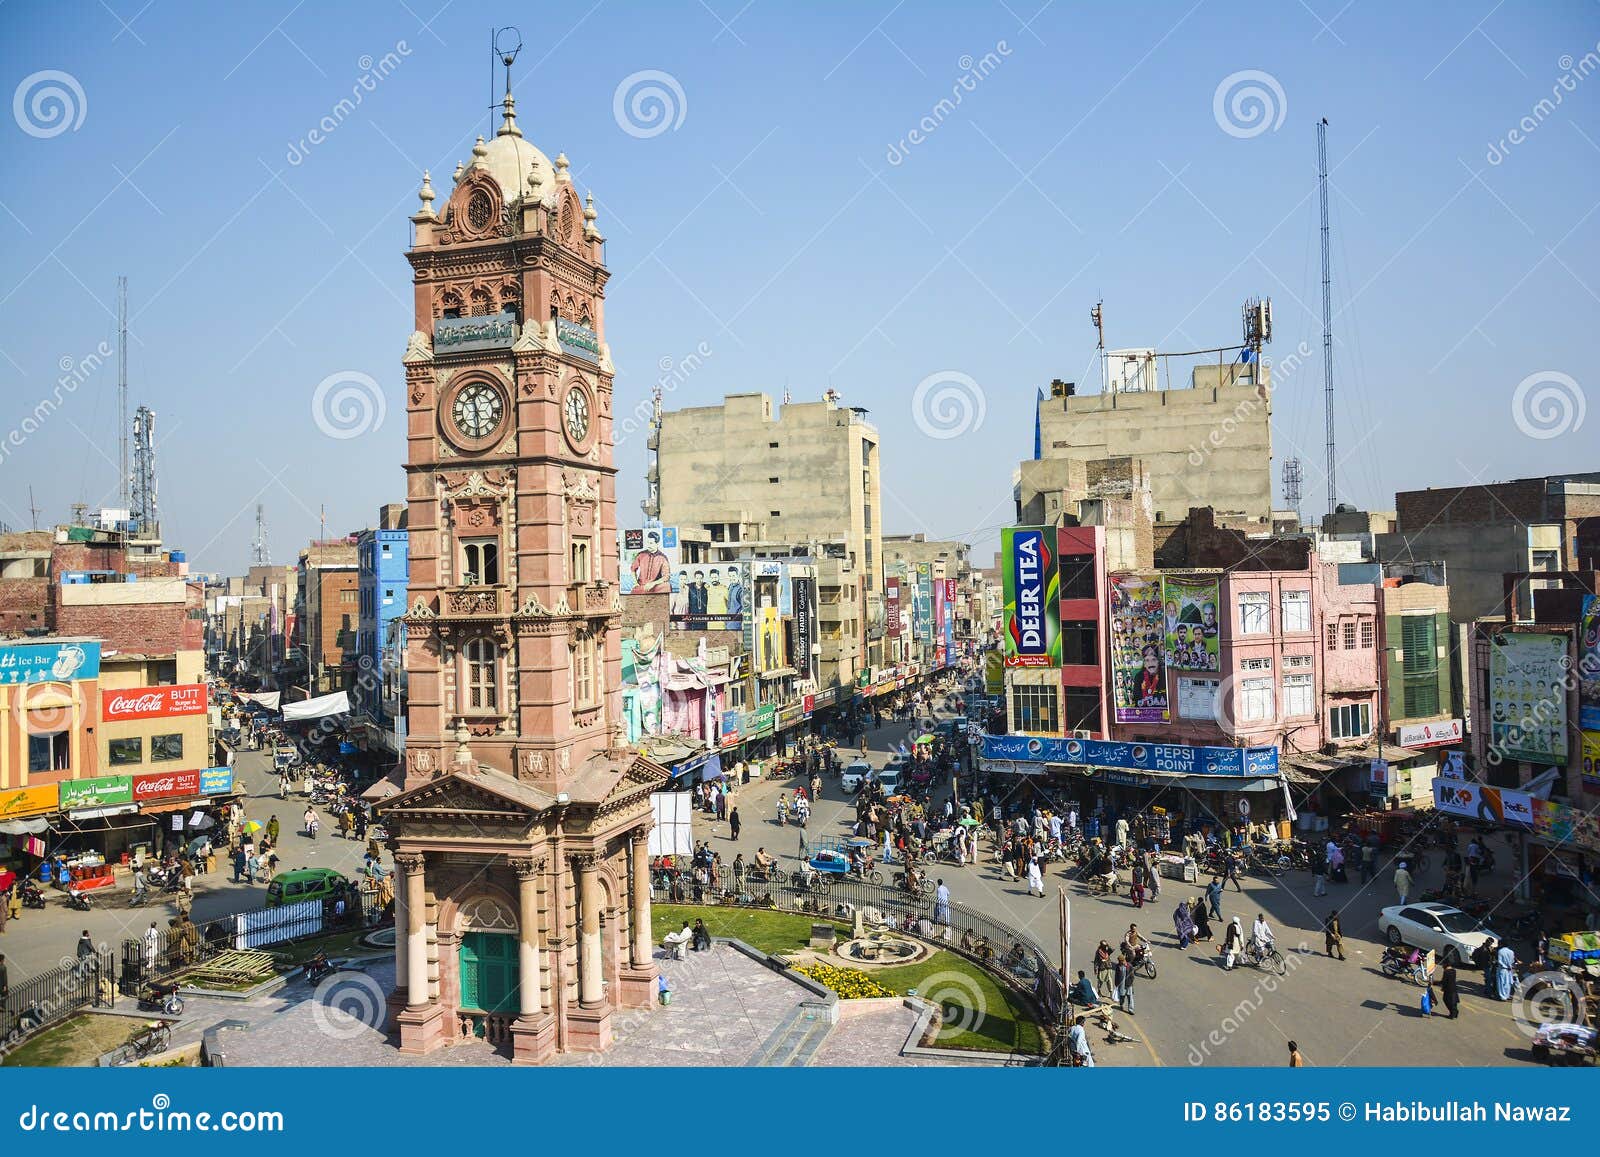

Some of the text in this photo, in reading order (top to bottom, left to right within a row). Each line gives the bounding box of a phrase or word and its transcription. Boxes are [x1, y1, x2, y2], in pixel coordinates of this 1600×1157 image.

[1019, 537, 1041, 647] DEER TEA
[19, 656, 32, 665] Ice
[35, 655, 51, 665] Bar
[171, 689, 199, 699] BUTT
[108, 693, 164, 714] Coca-Cola
[1154, 747, 1195, 760] PEPSI
[1156, 760, 1195, 771] POINT
[177, 775, 195, 783] BUTT
[136, 778, 174, 794] Coca-Cola
[1504, 801, 1528, 813] FedEx
